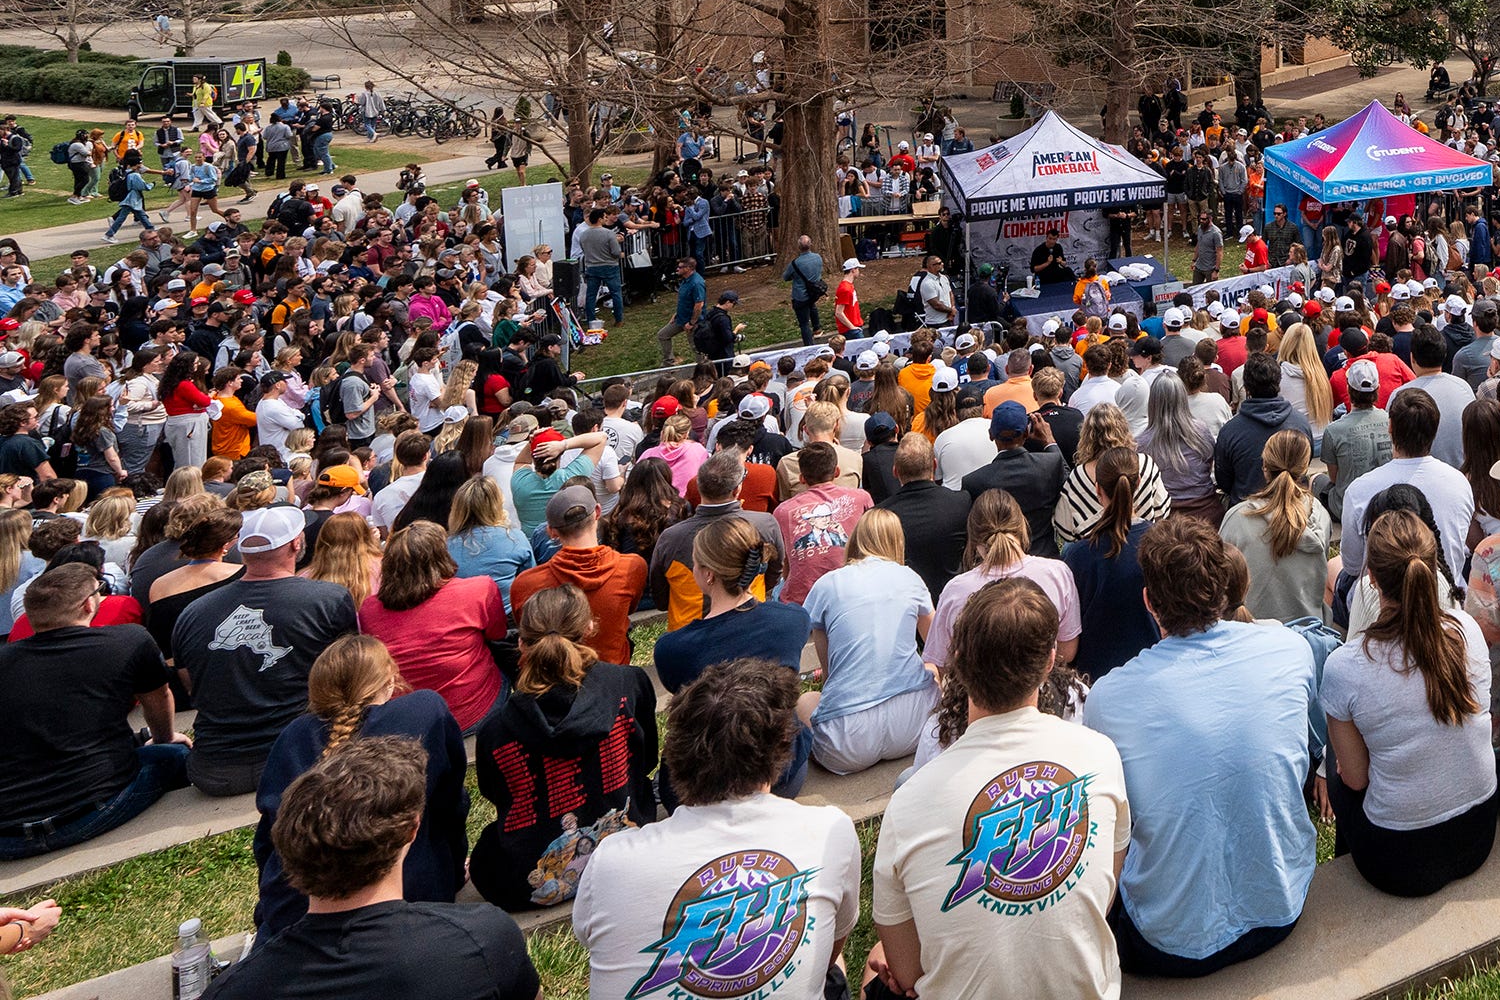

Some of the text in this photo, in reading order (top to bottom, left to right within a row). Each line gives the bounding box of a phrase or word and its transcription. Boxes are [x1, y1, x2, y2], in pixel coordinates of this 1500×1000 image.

[1032, 151, 1092, 174] AMERICAN
[1037, 154, 1100, 176] COMEBACK
[1374, 146, 1426, 157] STUDENTS
[1332, 172, 1484, 195] SAVE AMERICA GET INVOLVED
[971, 198, 1008, 216] PROVE
[1010, 197, 1026, 212] ME
[1027, 193, 1068, 210] WRONG
[1074, 190, 1110, 205] PROVE
[1111, 188, 1126, 203] ME
[1127, 185, 1165, 201] WRONG
[1004, 213, 1069, 239] COMEBACK
[211, 625, 272, 648] Local
[985, 765, 1059, 800] RUSH
[1087, 821, 1098, 849] TN
[698, 854, 781, 887] RUSH
[989, 834, 1082, 895] SPRING 2025
[801, 916, 816, 946] TN
[685, 930, 798, 993] SPRING 2025
